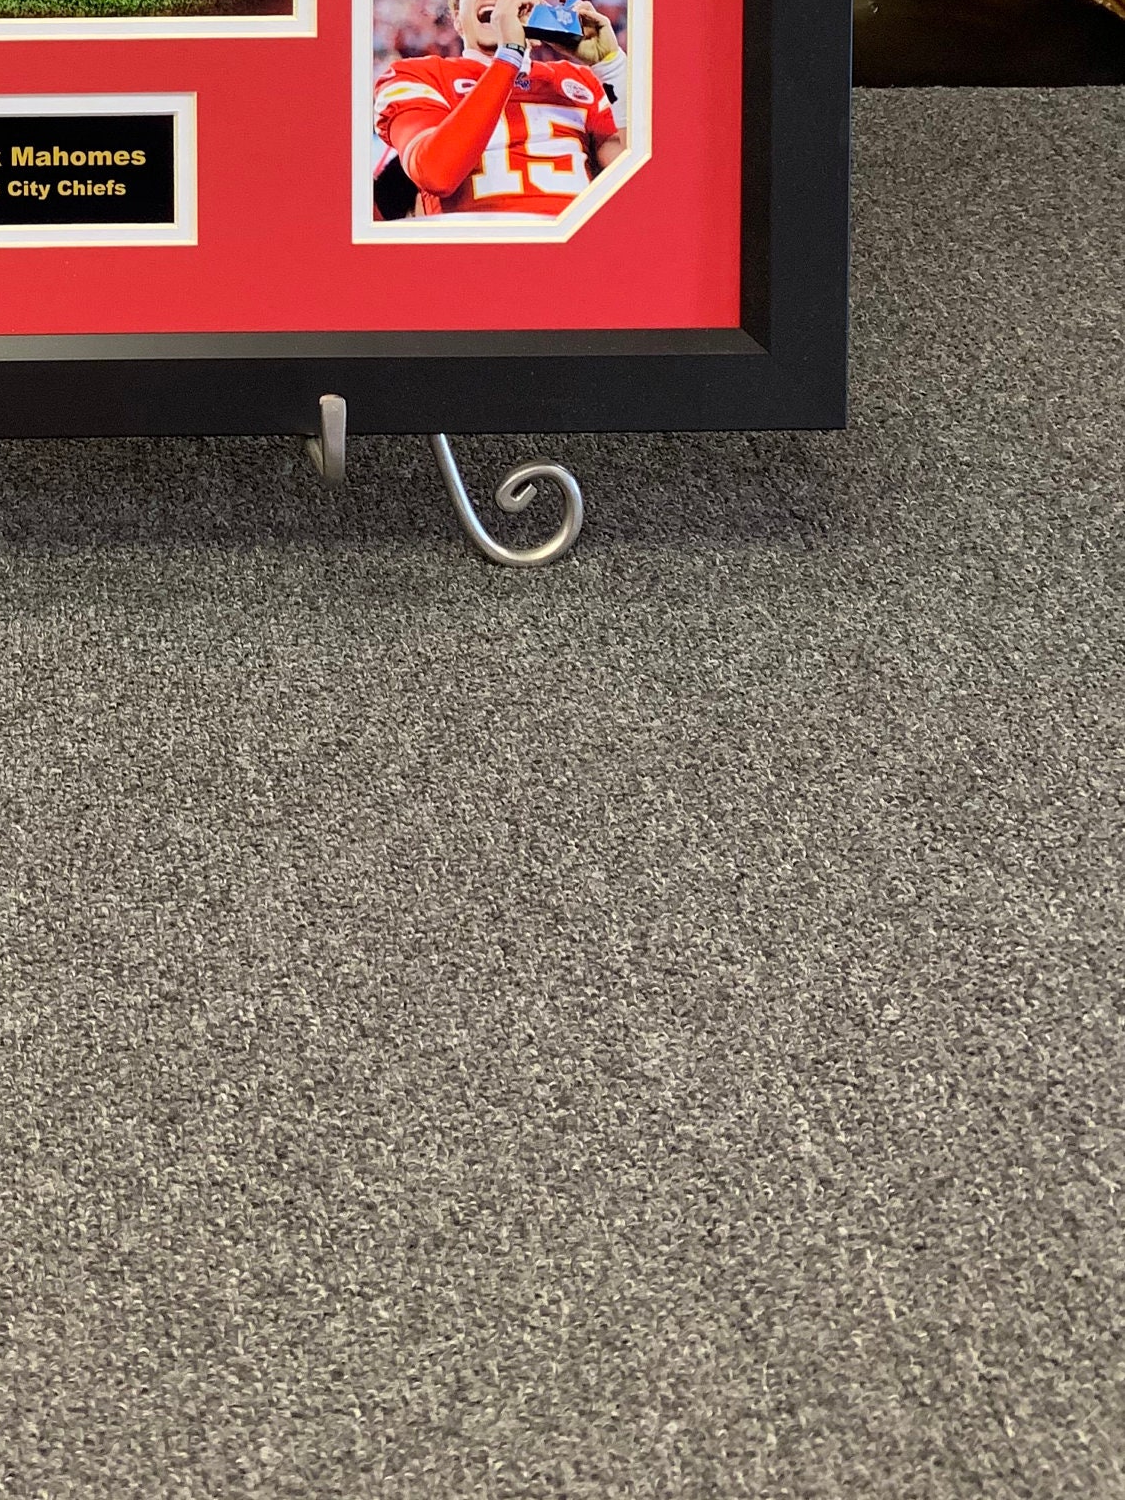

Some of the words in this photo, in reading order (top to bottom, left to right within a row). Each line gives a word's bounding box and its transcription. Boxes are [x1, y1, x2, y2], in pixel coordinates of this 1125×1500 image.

[11, 146, 146, 167] Mahomes
[472, 102, 592, 200] 15
[7, 181, 51, 200] City
[57, 180, 127, 197] Chiefs
